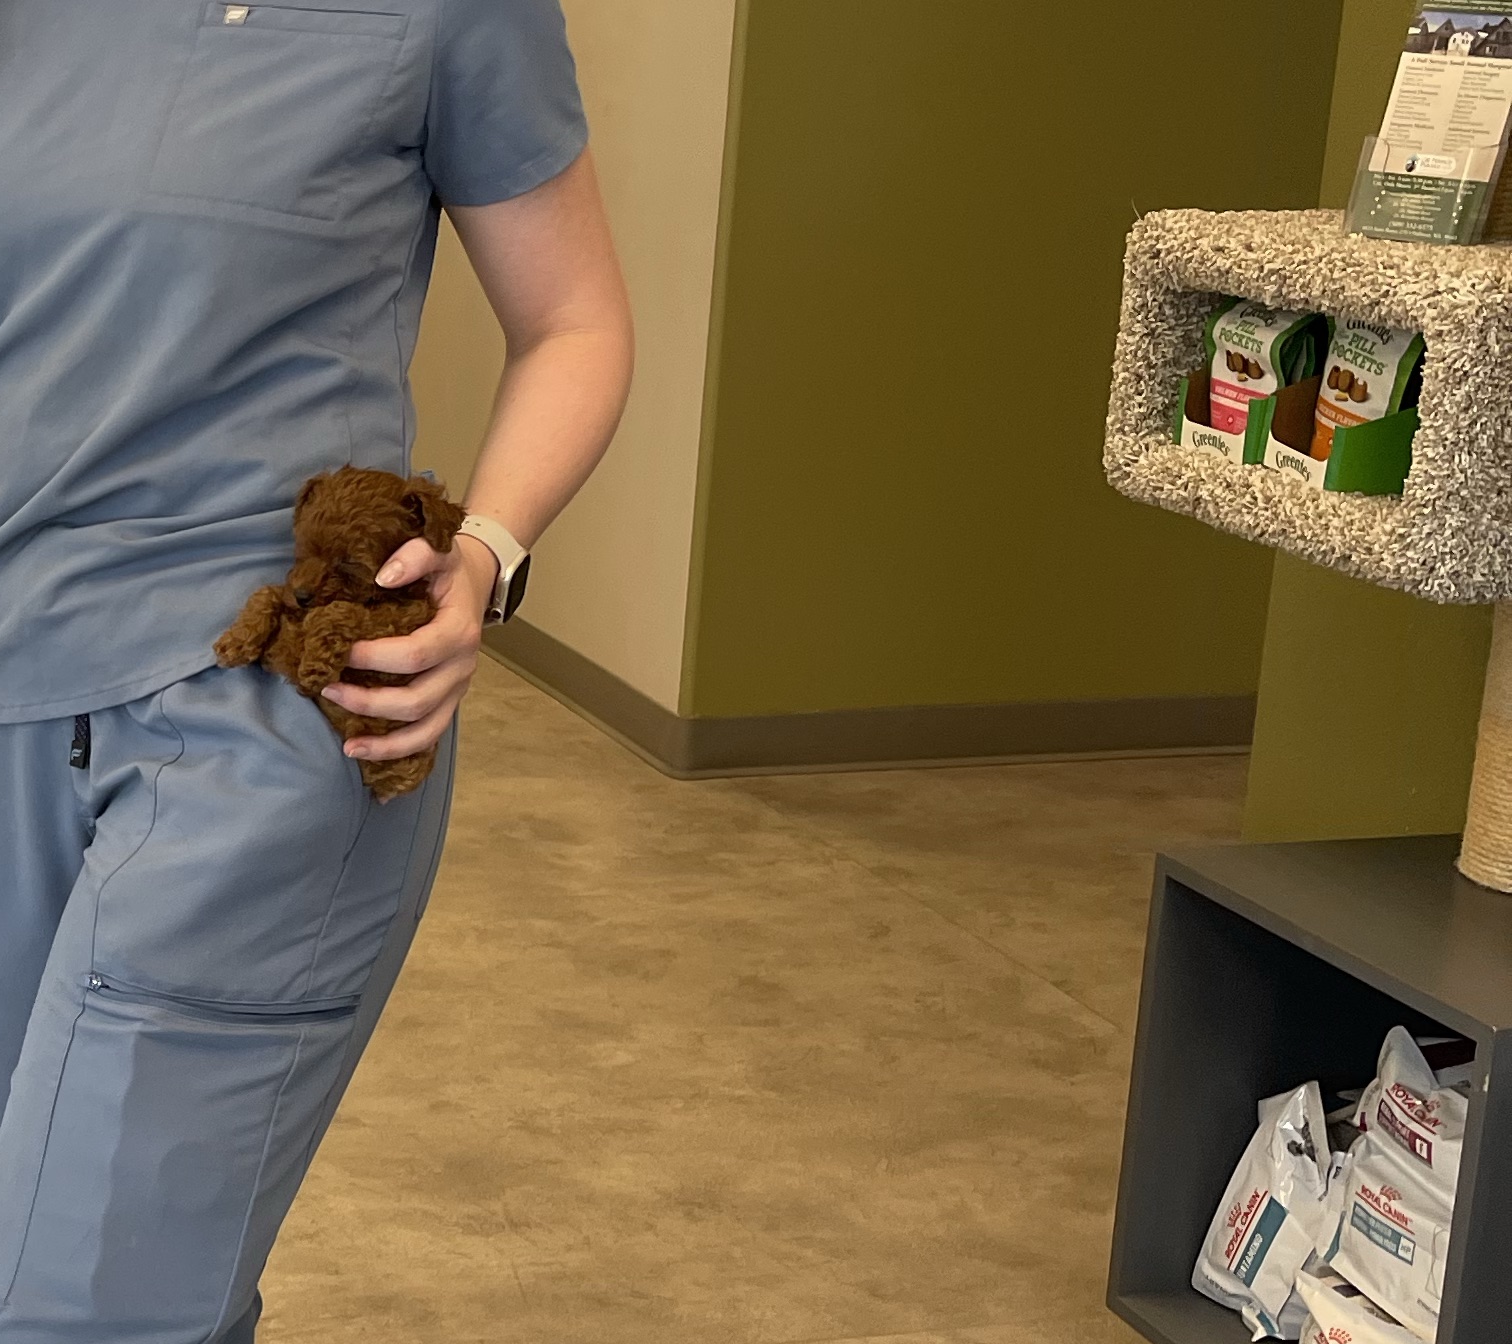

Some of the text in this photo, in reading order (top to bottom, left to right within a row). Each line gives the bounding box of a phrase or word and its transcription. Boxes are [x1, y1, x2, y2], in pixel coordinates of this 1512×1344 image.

[1218, 326, 1265, 354] POCKETS
[1348, 332, 1377, 356] PILL
[1331, 340, 1386, 376] POCKETS
[1192, 430, 1231, 457] Greenies
[1275, 450, 1312, 483] Greenies
